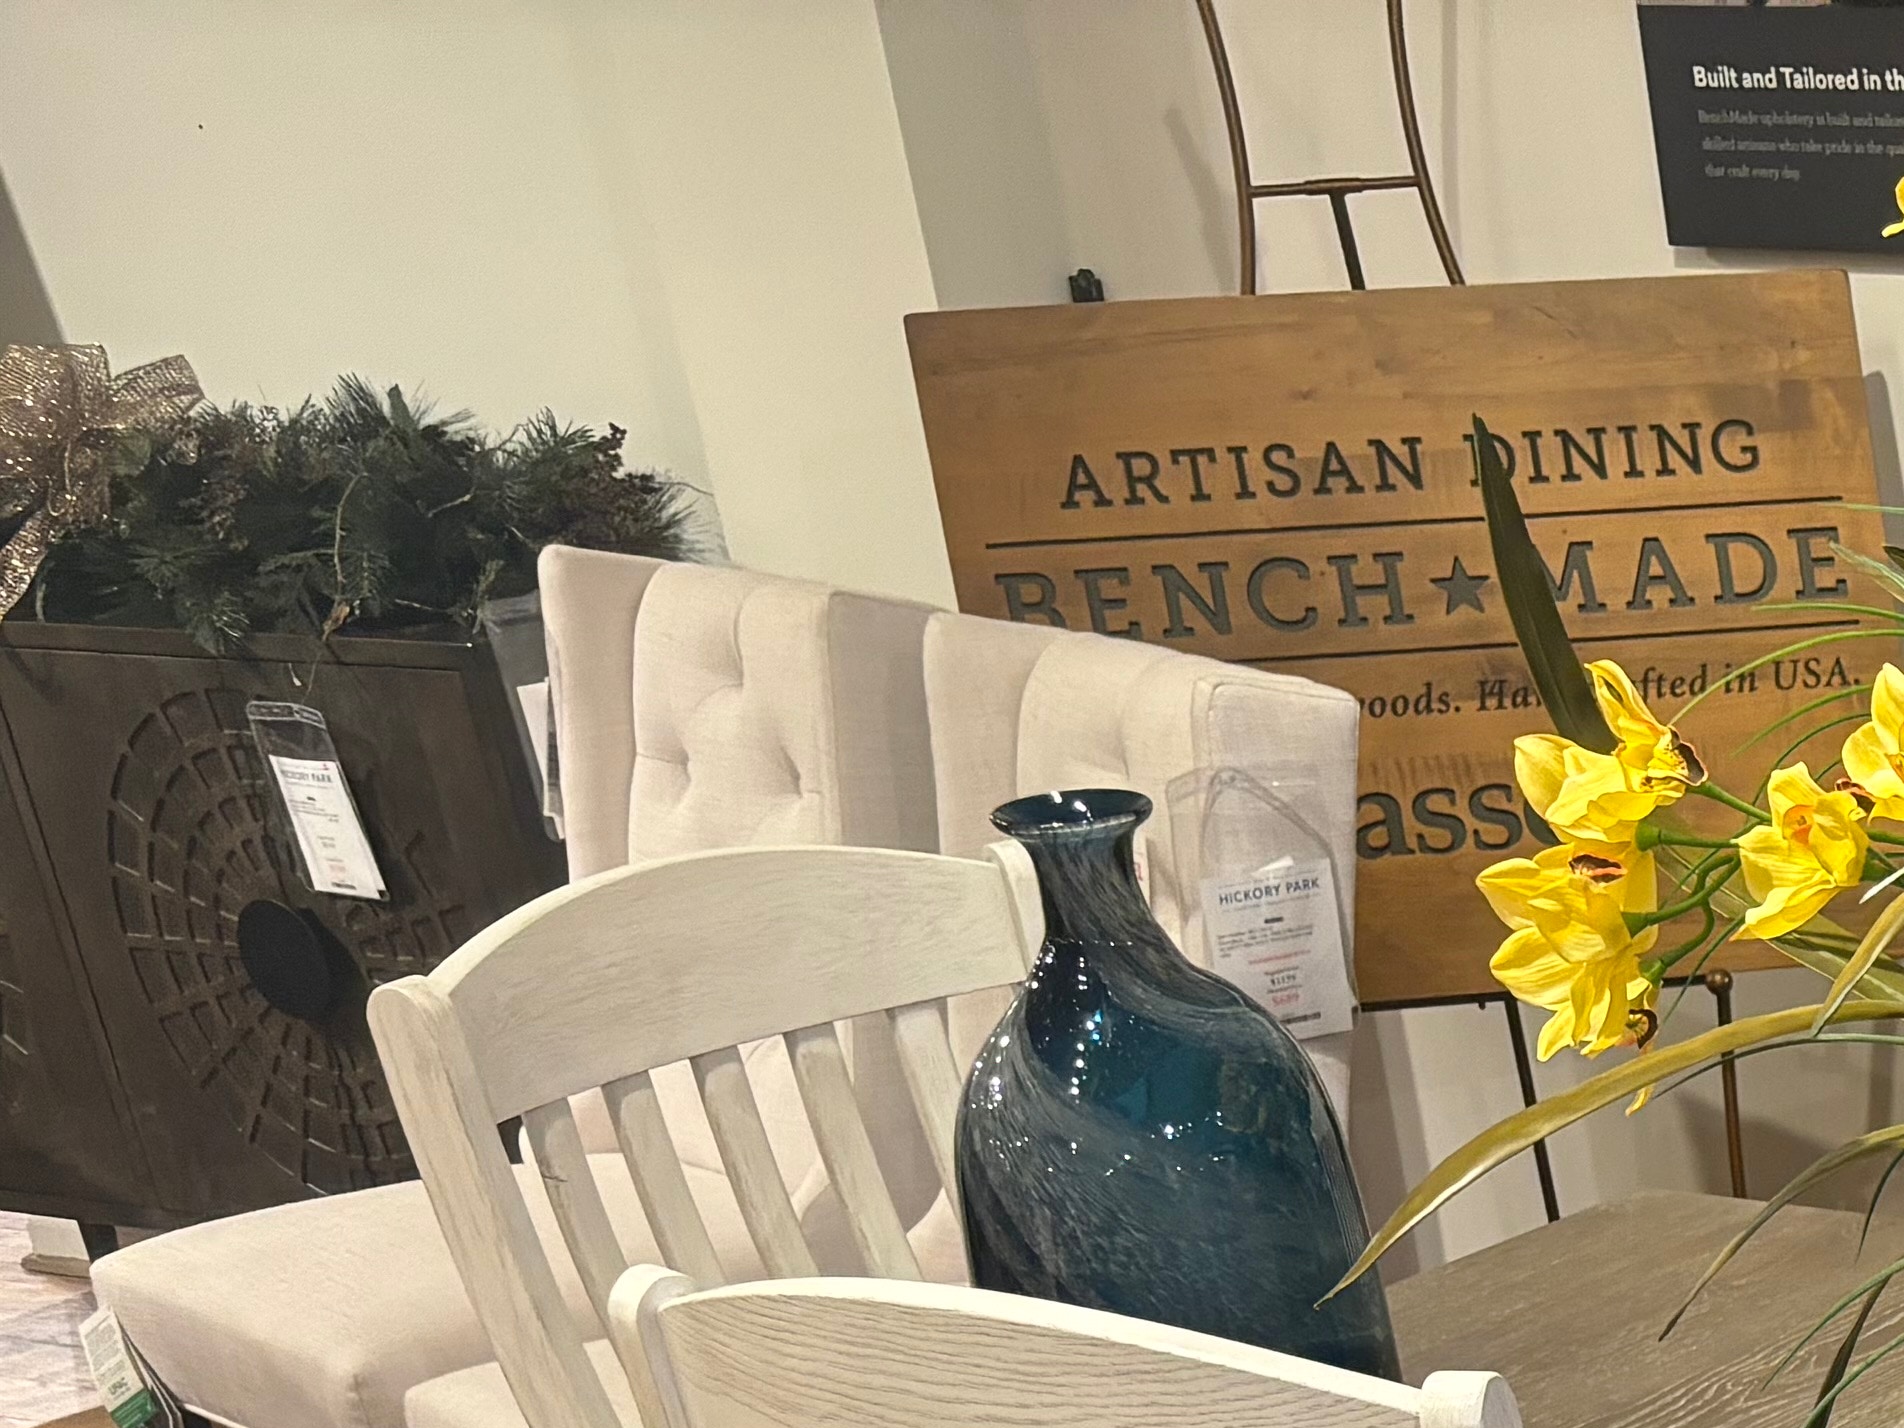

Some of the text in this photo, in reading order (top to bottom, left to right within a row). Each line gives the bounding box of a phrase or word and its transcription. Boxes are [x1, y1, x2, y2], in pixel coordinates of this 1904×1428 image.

[1693, 66, 1738, 88] Built
[1742, 67, 1777, 89] and
[1780, 67, 1859, 90] Tailored
[1862, 69, 1881, 91] in
[1060, 419, 1760, 509] ARTISAN DINING
[994, 526, 1849, 640] BENCH MADE
[1359, 682, 1460, 718] oods.
[1723, 662, 1758, 694] in
[1773, 656, 1861, 693] USA.
[1218, 884, 1281, 906] HICKORY
[1286, 878, 1320, 895] PARK
